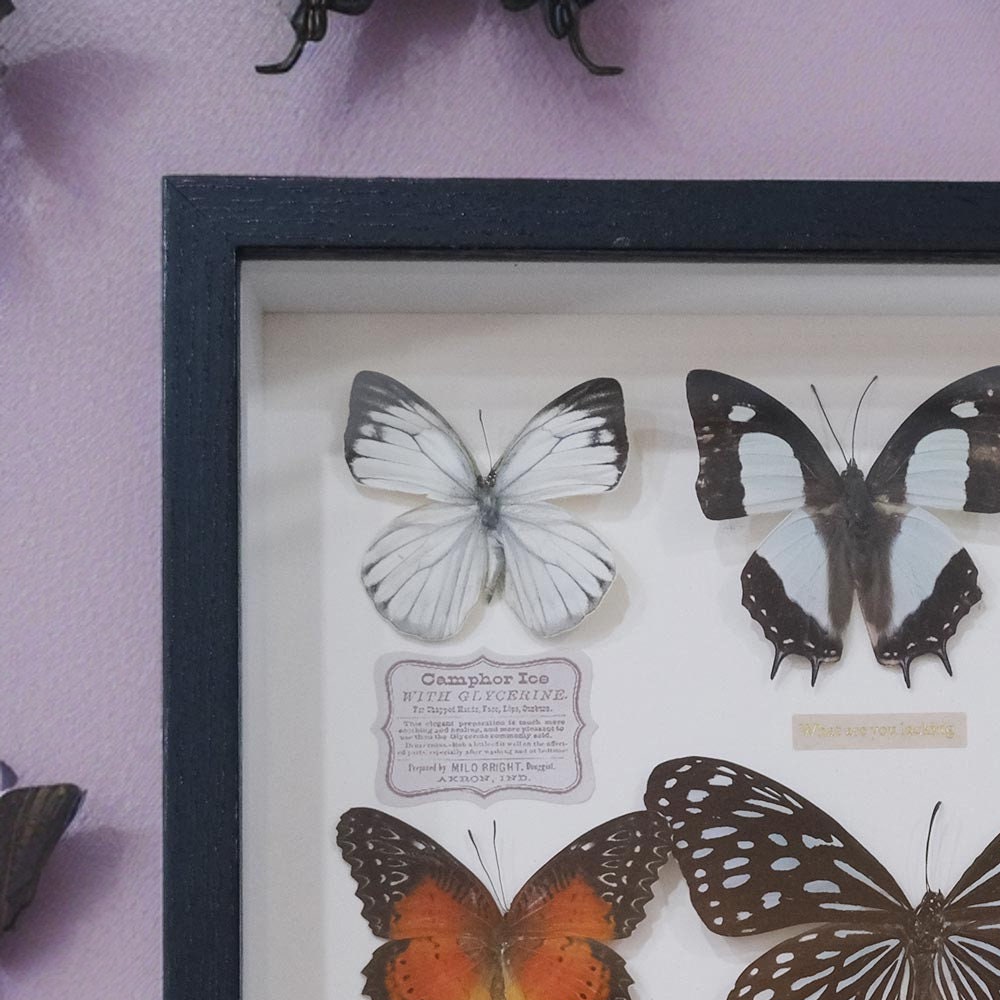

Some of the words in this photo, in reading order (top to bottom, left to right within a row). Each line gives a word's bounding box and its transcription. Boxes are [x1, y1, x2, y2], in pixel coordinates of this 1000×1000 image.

[420, 672, 514, 688] Camphor
[517, 672, 550, 686] Ice
[401, 690, 451, 703] WITH
[457, 689, 568, 702] GLYCERINE.
[451, 762, 479, 773] MILO
